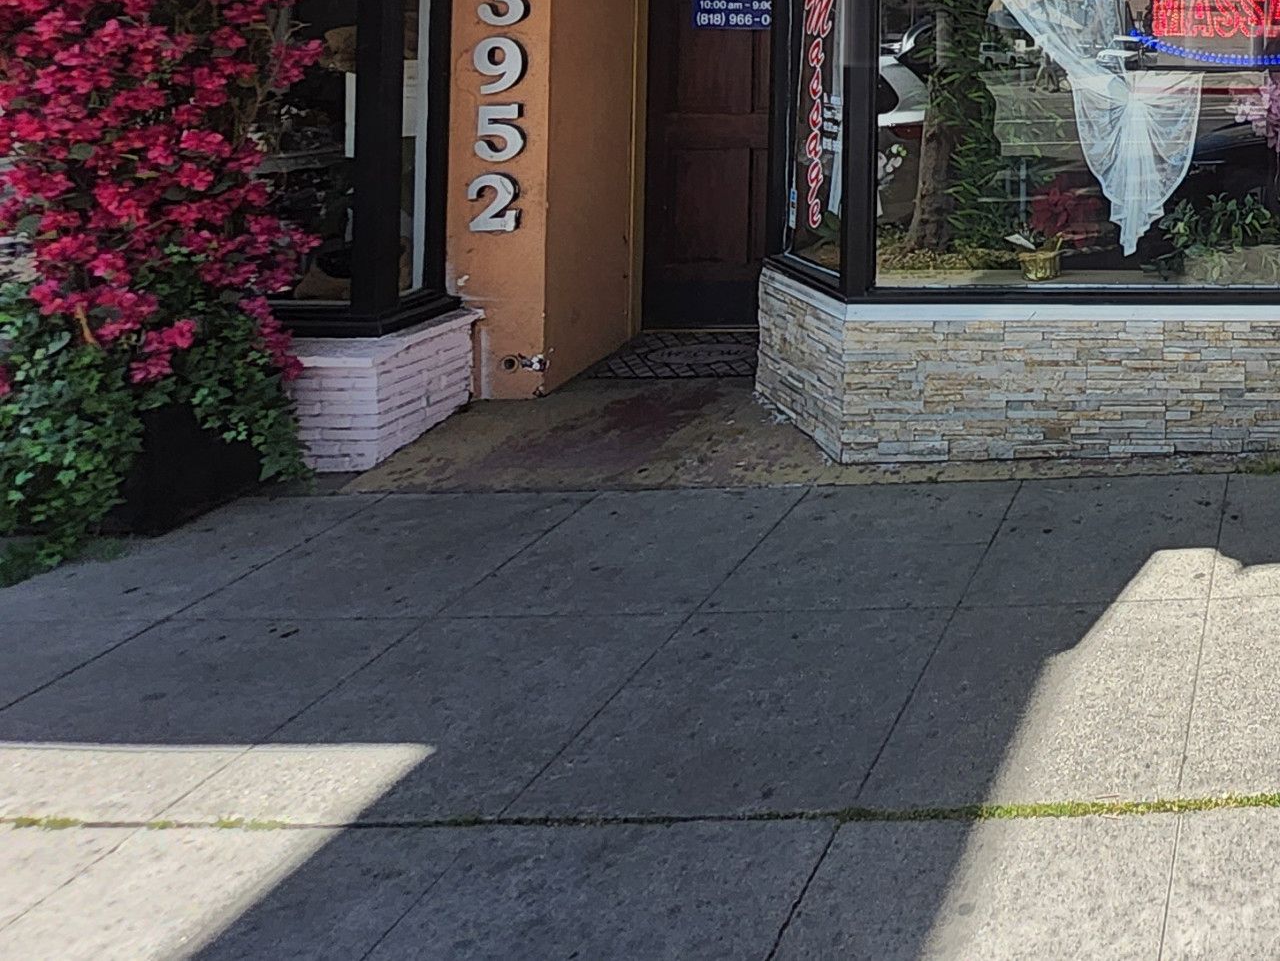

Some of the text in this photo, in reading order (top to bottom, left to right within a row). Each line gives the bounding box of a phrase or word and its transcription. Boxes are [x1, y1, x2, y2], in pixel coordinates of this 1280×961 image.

[700, 0, 726, 9] 10:00
[728, 2, 743, 10] am
[696, 11, 772, 26] (818) 966-0
